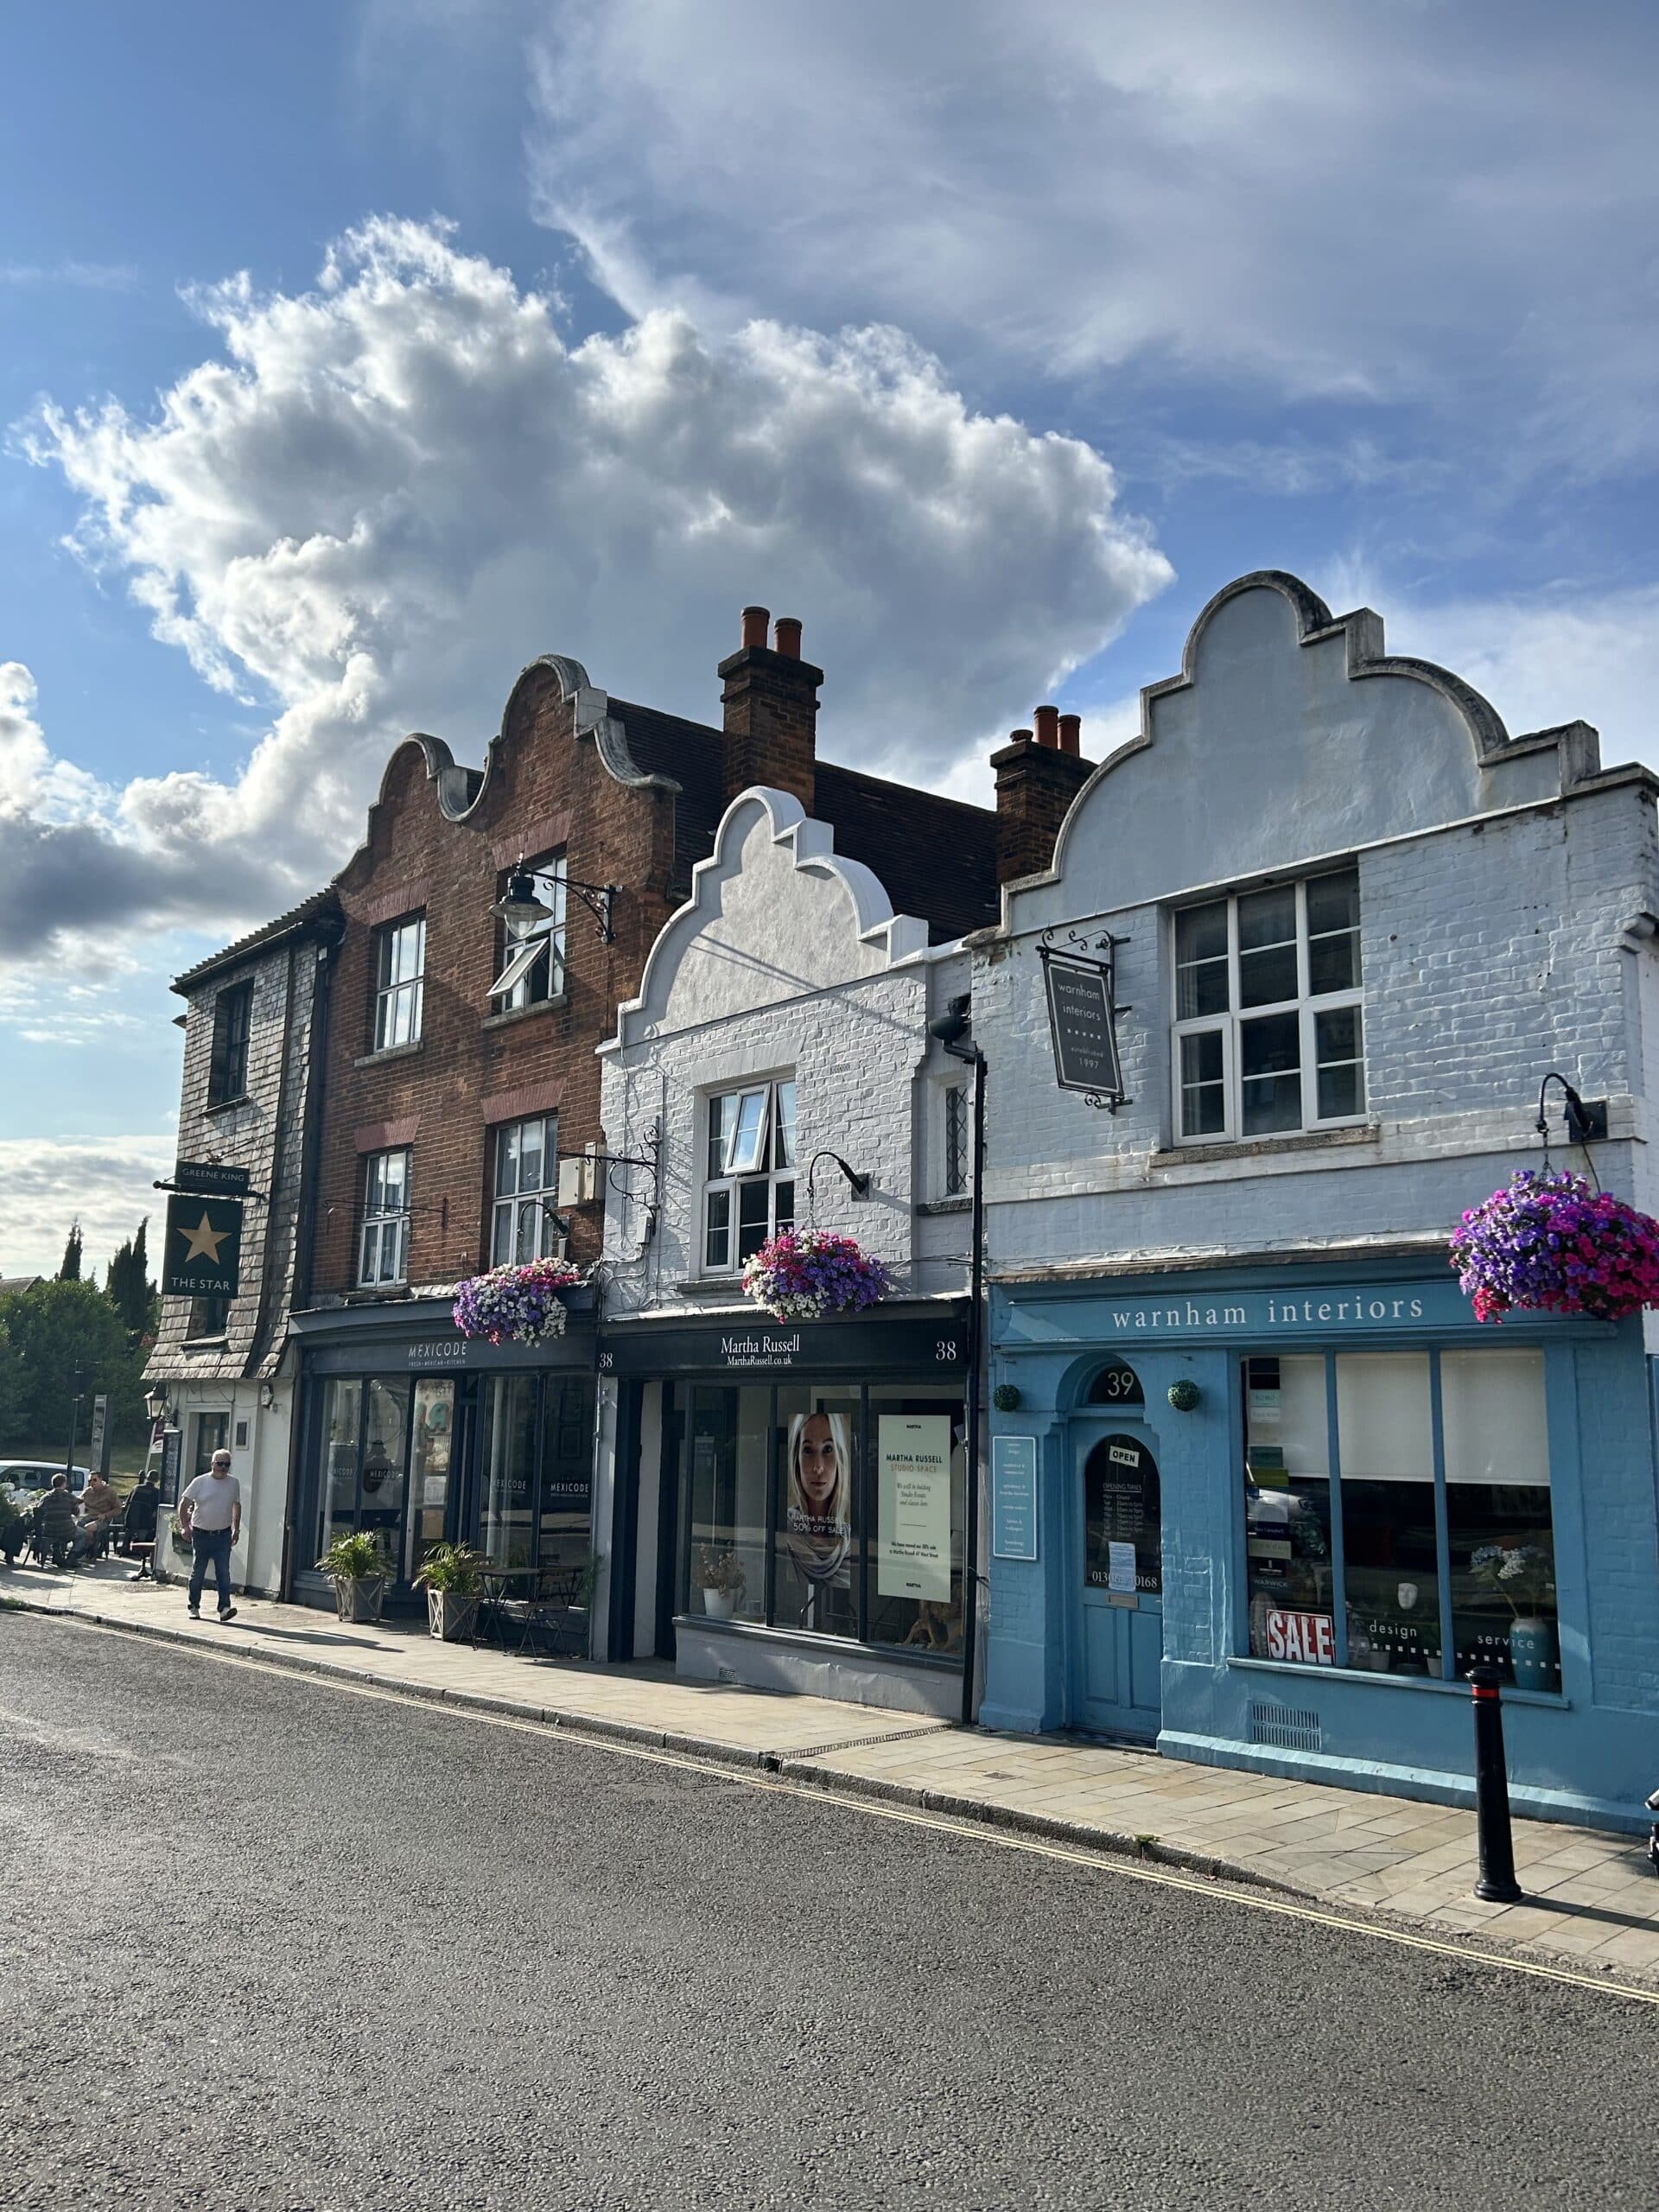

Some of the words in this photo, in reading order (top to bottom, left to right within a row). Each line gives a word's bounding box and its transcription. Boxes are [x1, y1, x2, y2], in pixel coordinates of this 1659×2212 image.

[1058, 982, 1100, 1001] warnham
[1063, 1003, 1101, 1021] interiors
[1078, 1057, 1100, 1070] 1997
[182, 1168, 219, 1179] GREENE
[221, 1173, 245, 1182] KING
[171, 1277, 196, 1288] THE
[200, 1279, 230, 1291] STAR
[1113, 1301, 1247, 1328] warnham
[1268, 1296, 1424, 1323] interiors
[408, 1341, 467, 1358] MEXICODE
[720, 1335, 759, 1353] Martha
[762, 1333, 799, 1352] Russell
[936, 1340, 957, 1361] 38
[599, 1352, 613, 1368] 38
[727, 1353, 792, 1366] MarthaRussell.co.uk
[1107, 1371, 1134, 1396] 39
[886, 1453, 913, 1462] MARTHA
[915, 1454, 943, 1464] RUSSELL
[1112, 1450, 1135, 1463] OPEN
[891, 1464, 914, 1472] STUDIO
[917, 1465, 938, 1473] SPACE
[550, 1483, 589, 1493] MEXICODE
[793, 1522, 810, 1532] 50%
[1369, 1619, 1417, 1640] design
[1269, 1612, 1332, 1664] SALE
[1478, 1635, 1535, 1649] service
